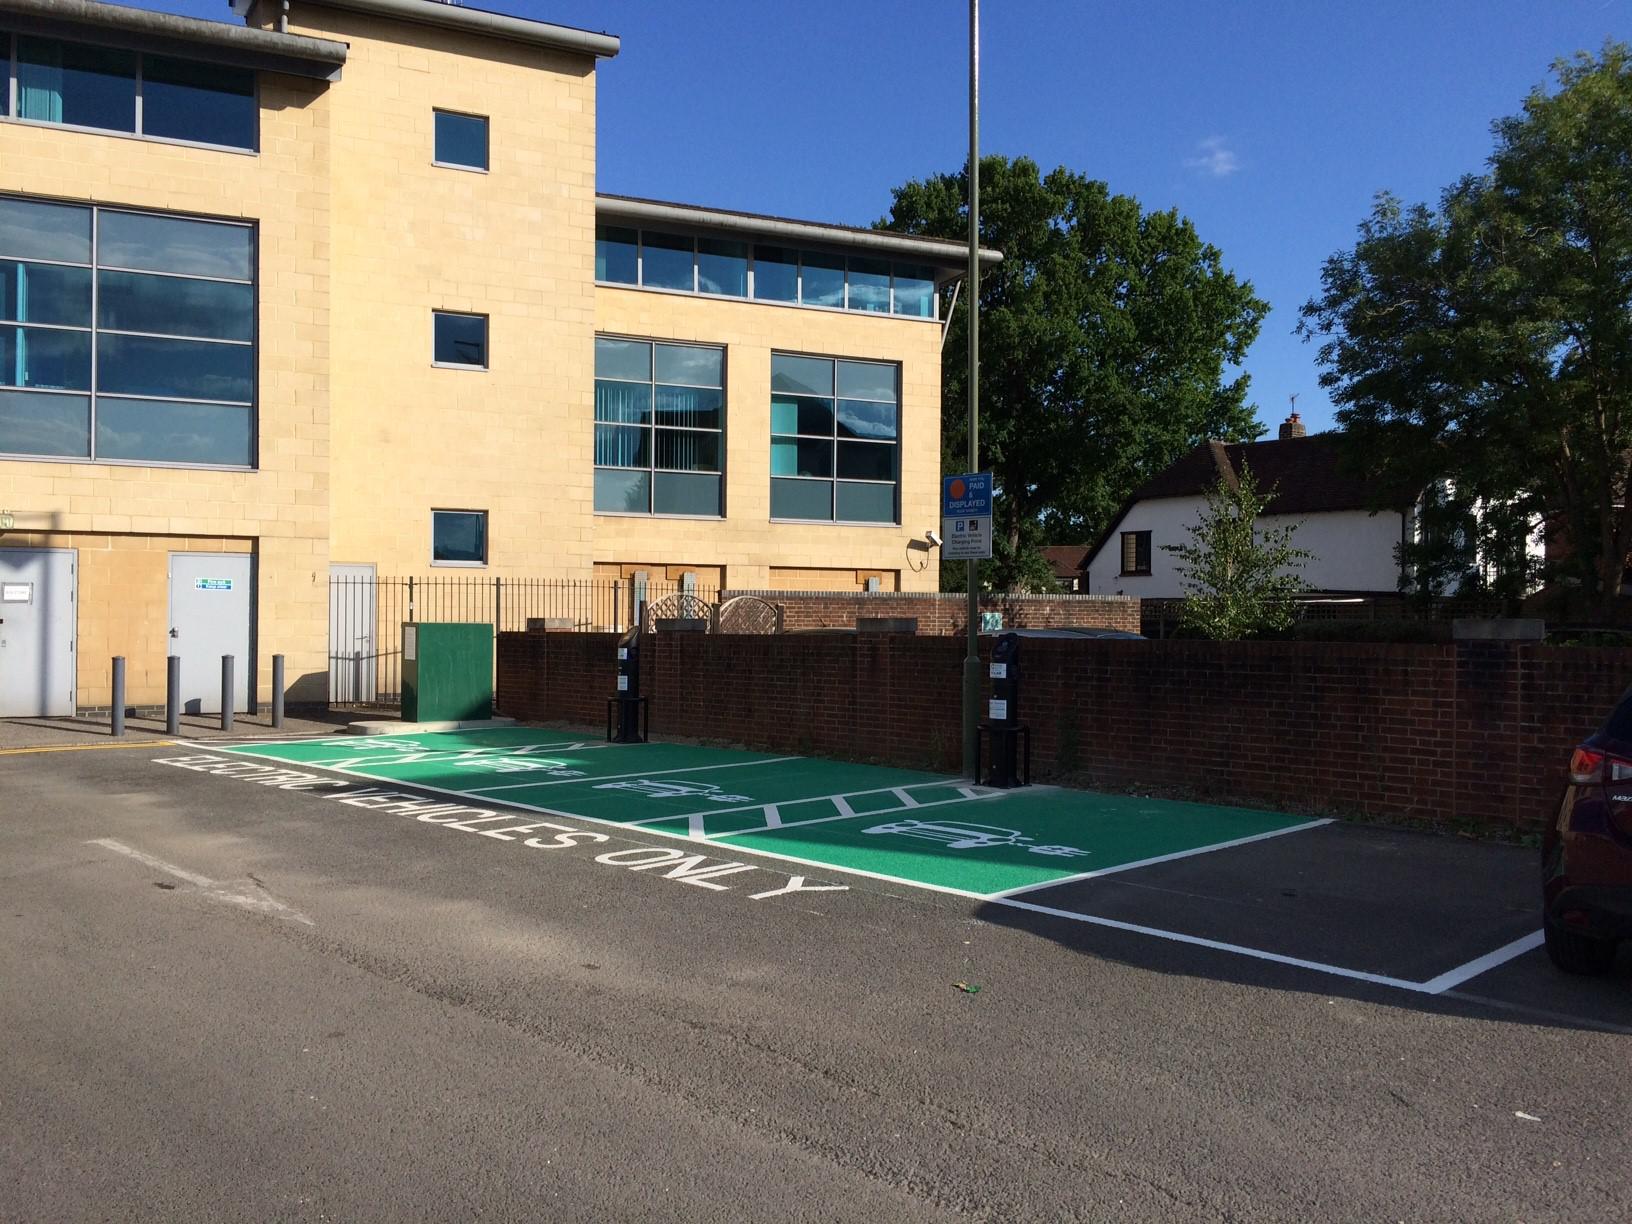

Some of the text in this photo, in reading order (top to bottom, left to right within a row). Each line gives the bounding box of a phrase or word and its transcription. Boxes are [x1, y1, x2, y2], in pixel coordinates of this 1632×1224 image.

[969, 482, 985, 490] PAID
[949, 499, 985, 509] DISPLAYED
[151, 755, 849, 899] ELECTRIC VEHICLES ONLY
